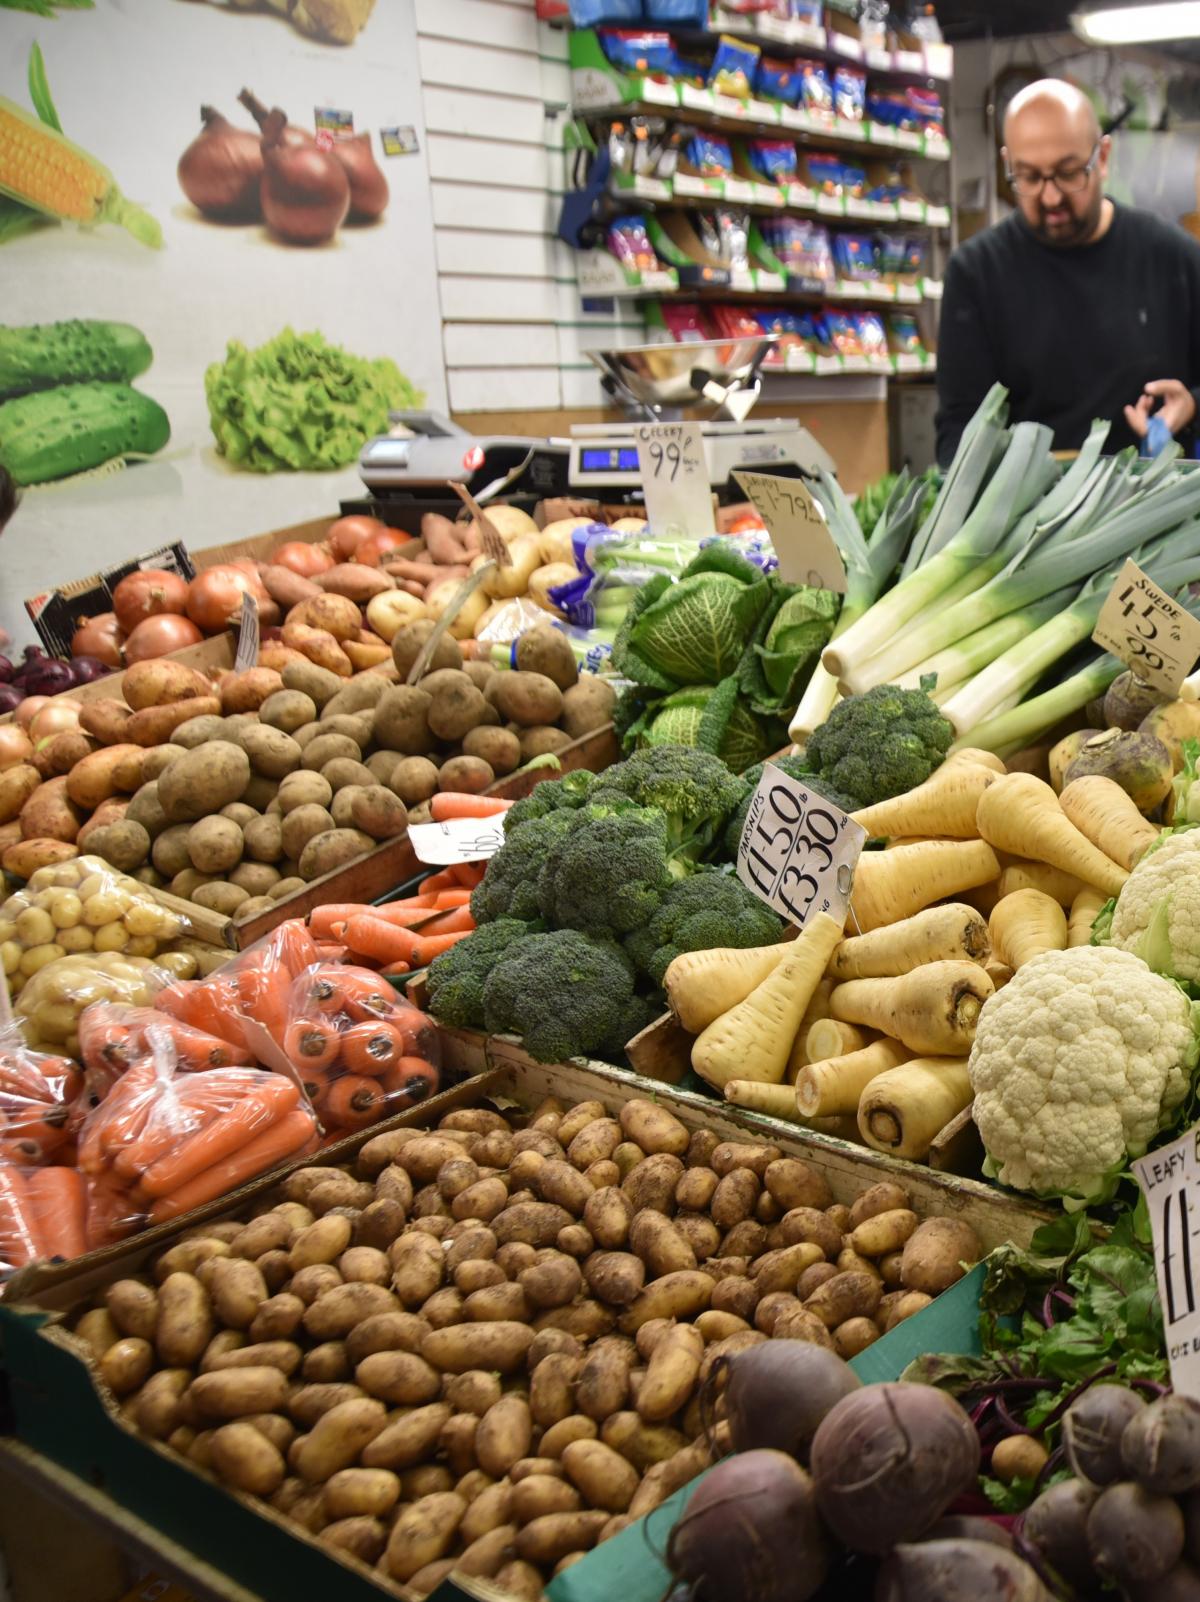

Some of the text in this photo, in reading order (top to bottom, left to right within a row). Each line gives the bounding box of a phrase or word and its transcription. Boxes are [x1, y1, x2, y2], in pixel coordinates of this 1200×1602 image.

[1118, 585, 1170, 640] 45
[1135, 578, 1182, 620] SWEDE
[740, 790, 765, 860] PARSNIPS
[1141, 1149, 1187, 1190] LEAFY
